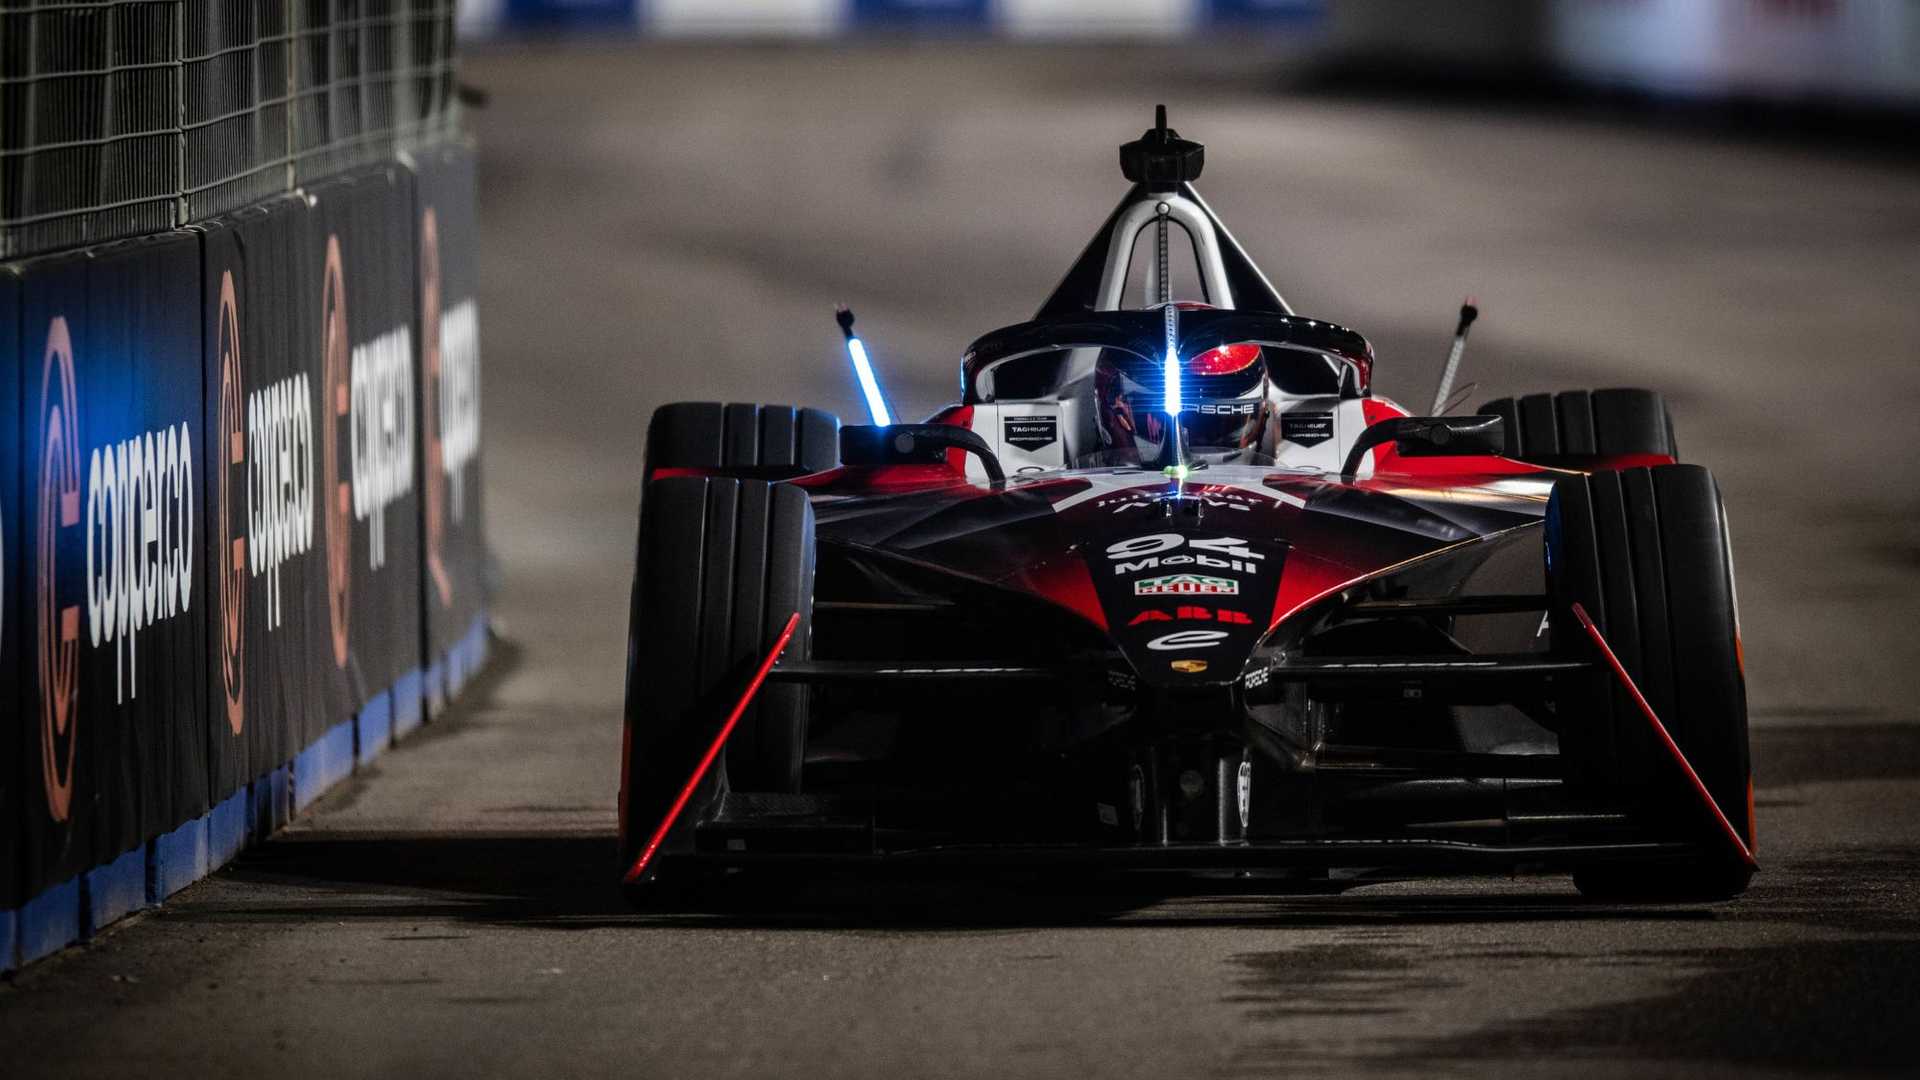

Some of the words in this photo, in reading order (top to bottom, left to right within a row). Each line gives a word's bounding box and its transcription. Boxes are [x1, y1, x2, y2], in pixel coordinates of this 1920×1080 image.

[1105, 533, 1265, 559] 94
[1114, 554, 1257, 574] Mobil
[1128, 606, 1253, 626] ABB
